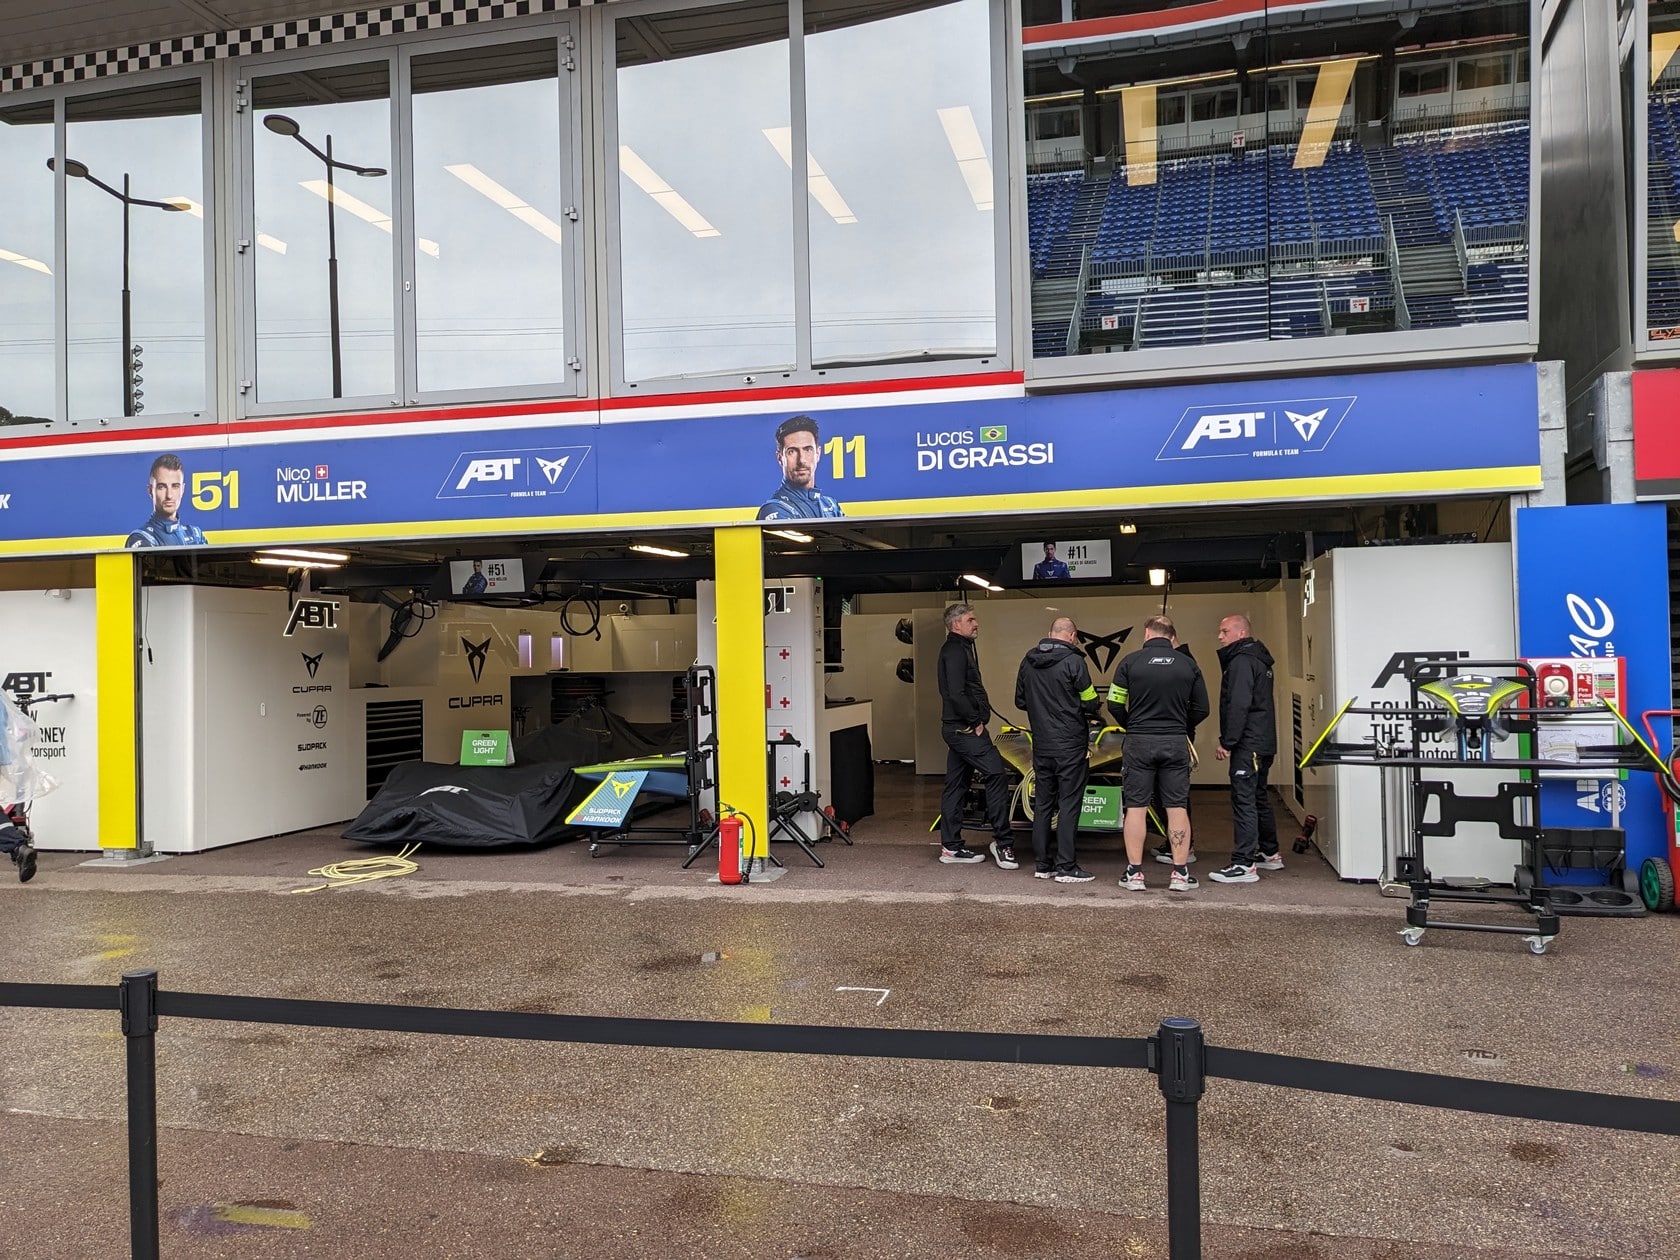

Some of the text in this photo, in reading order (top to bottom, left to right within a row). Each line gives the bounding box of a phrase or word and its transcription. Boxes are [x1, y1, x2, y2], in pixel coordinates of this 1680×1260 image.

[916, 429, 974, 447] Lucas
[1181, 411, 1265, 450] ABT
[824, 435, 866, 480] 11
[917, 442, 1054, 471] DI GRASSI
[1252, 450, 1278, 458] FORMULA
[1284, 448, 1299, 456] TEAM
[277, 467, 310, 482] Nico
[456, 457, 521, 490] ABT
[191, 470, 239, 511] 51
[277, 479, 367, 503] MÜLLER
[1067, 545, 1087, 560] #11
[488, 563, 505, 576] #51
[283, 599, 340, 637] ABT
[1, 672, 52, 694] ABT
[292, 685, 332, 693] CUPRA
[449, 694, 503, 709] CUPRA
[313, 708, 328, 724] ZF
[1370, 723, 1405, 743] THE
[472, 739, 498, 747] GREEN
[1082, 796, 1107, 805] REEN
[1576, 779, 1601, 813] AB
[1081, 805, 1104, 813] IGHT
